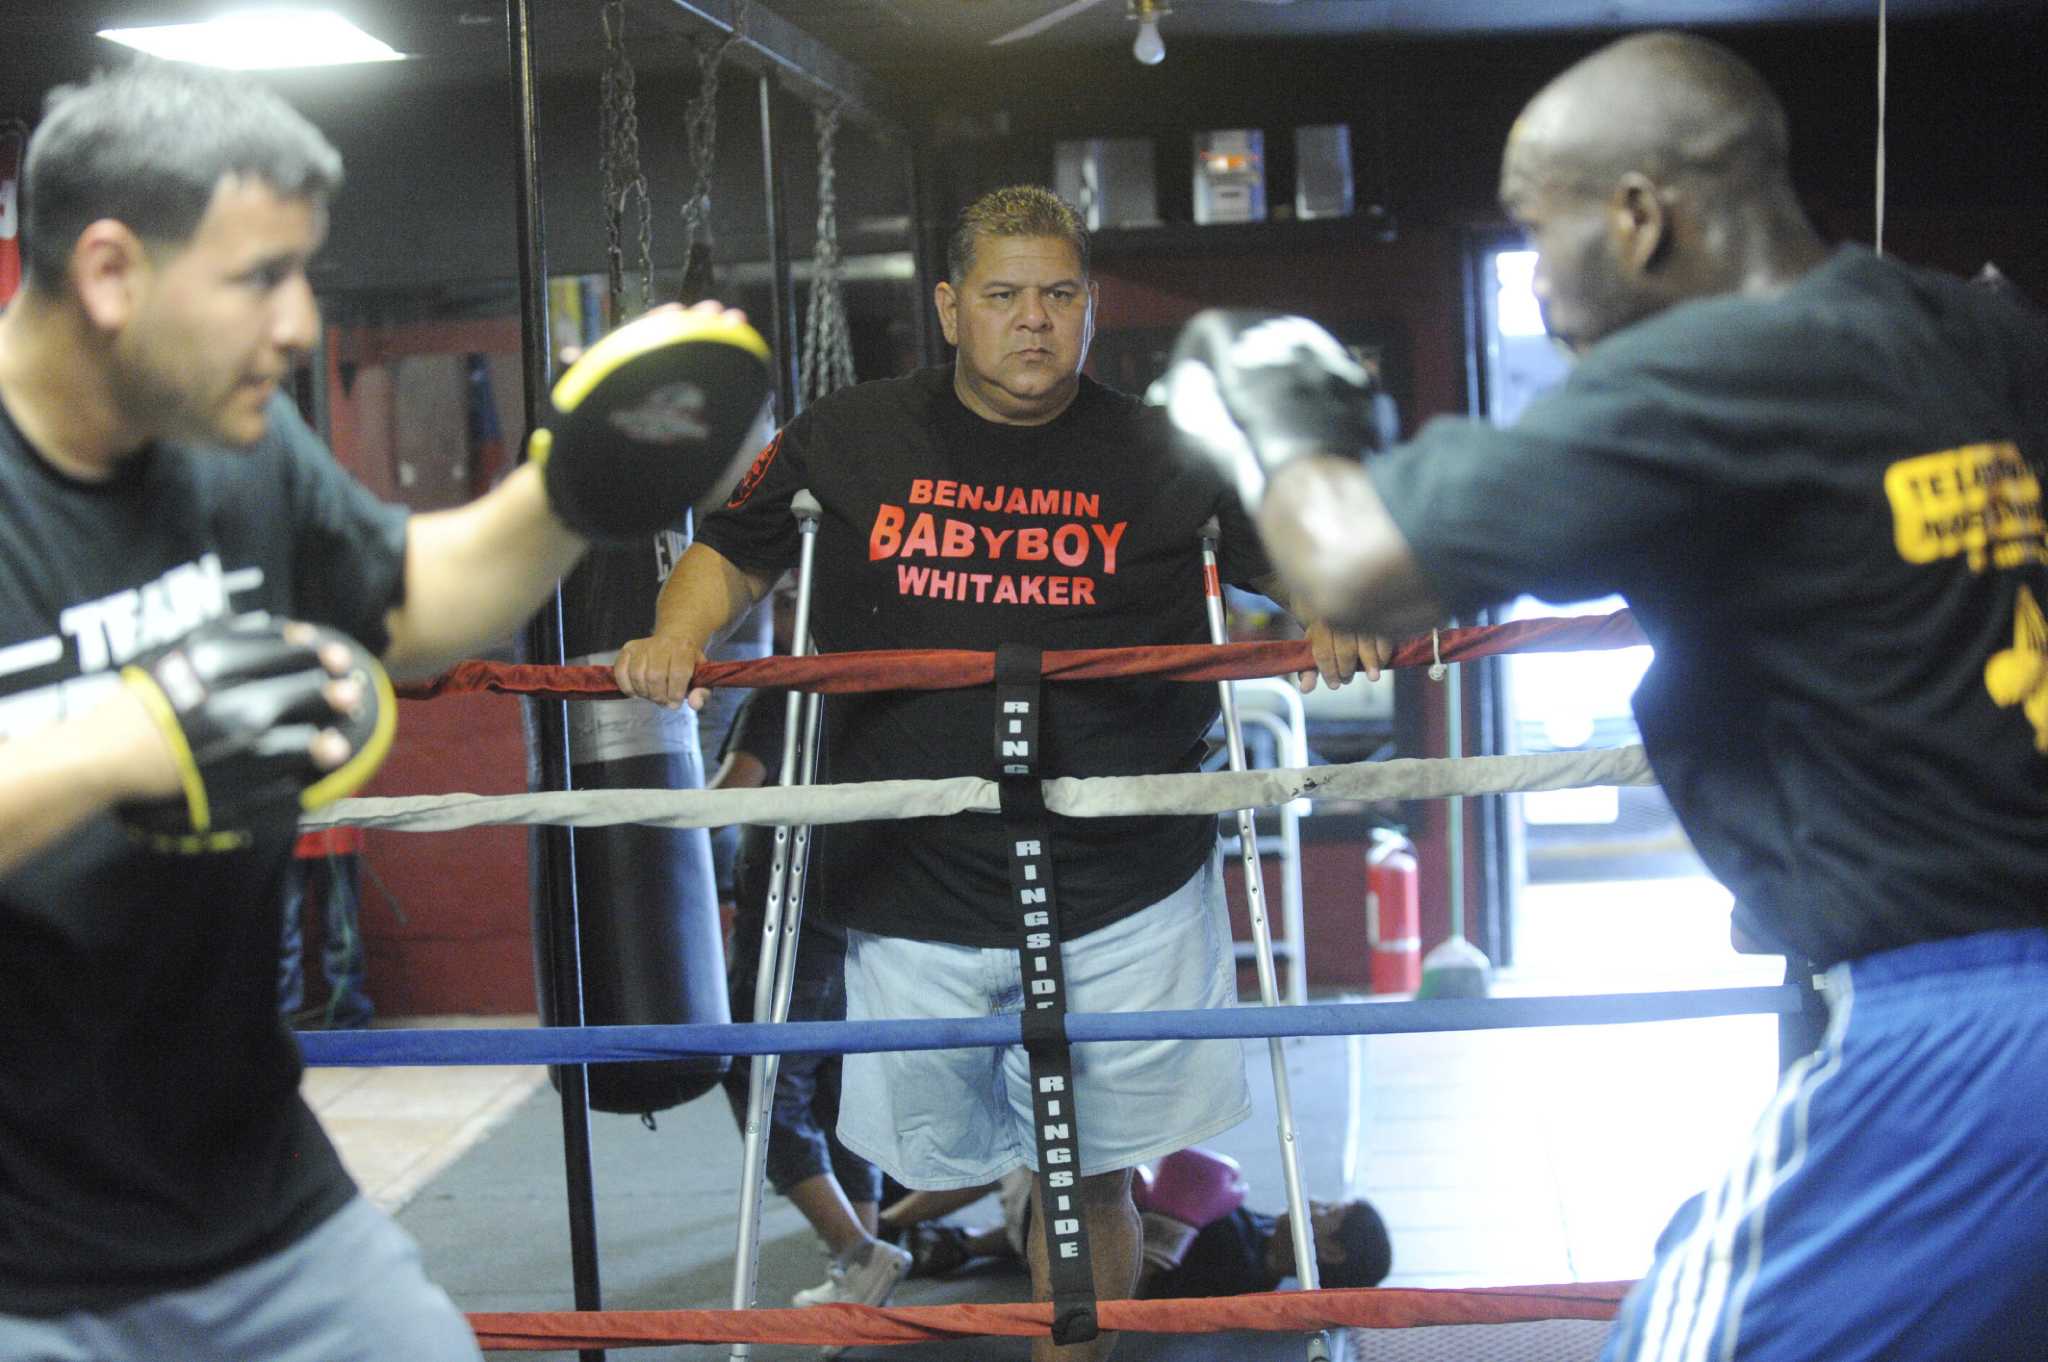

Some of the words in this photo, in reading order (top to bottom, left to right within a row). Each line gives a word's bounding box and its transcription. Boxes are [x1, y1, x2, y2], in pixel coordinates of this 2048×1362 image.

[908, 478, 1100, 518] BENJAMIN
[868, 503, 1128, 575] BABYBOY
[897, 564, 1097, 606] WHITAKER
[1039, 1075, 1080, 1259] RINGSIDE
